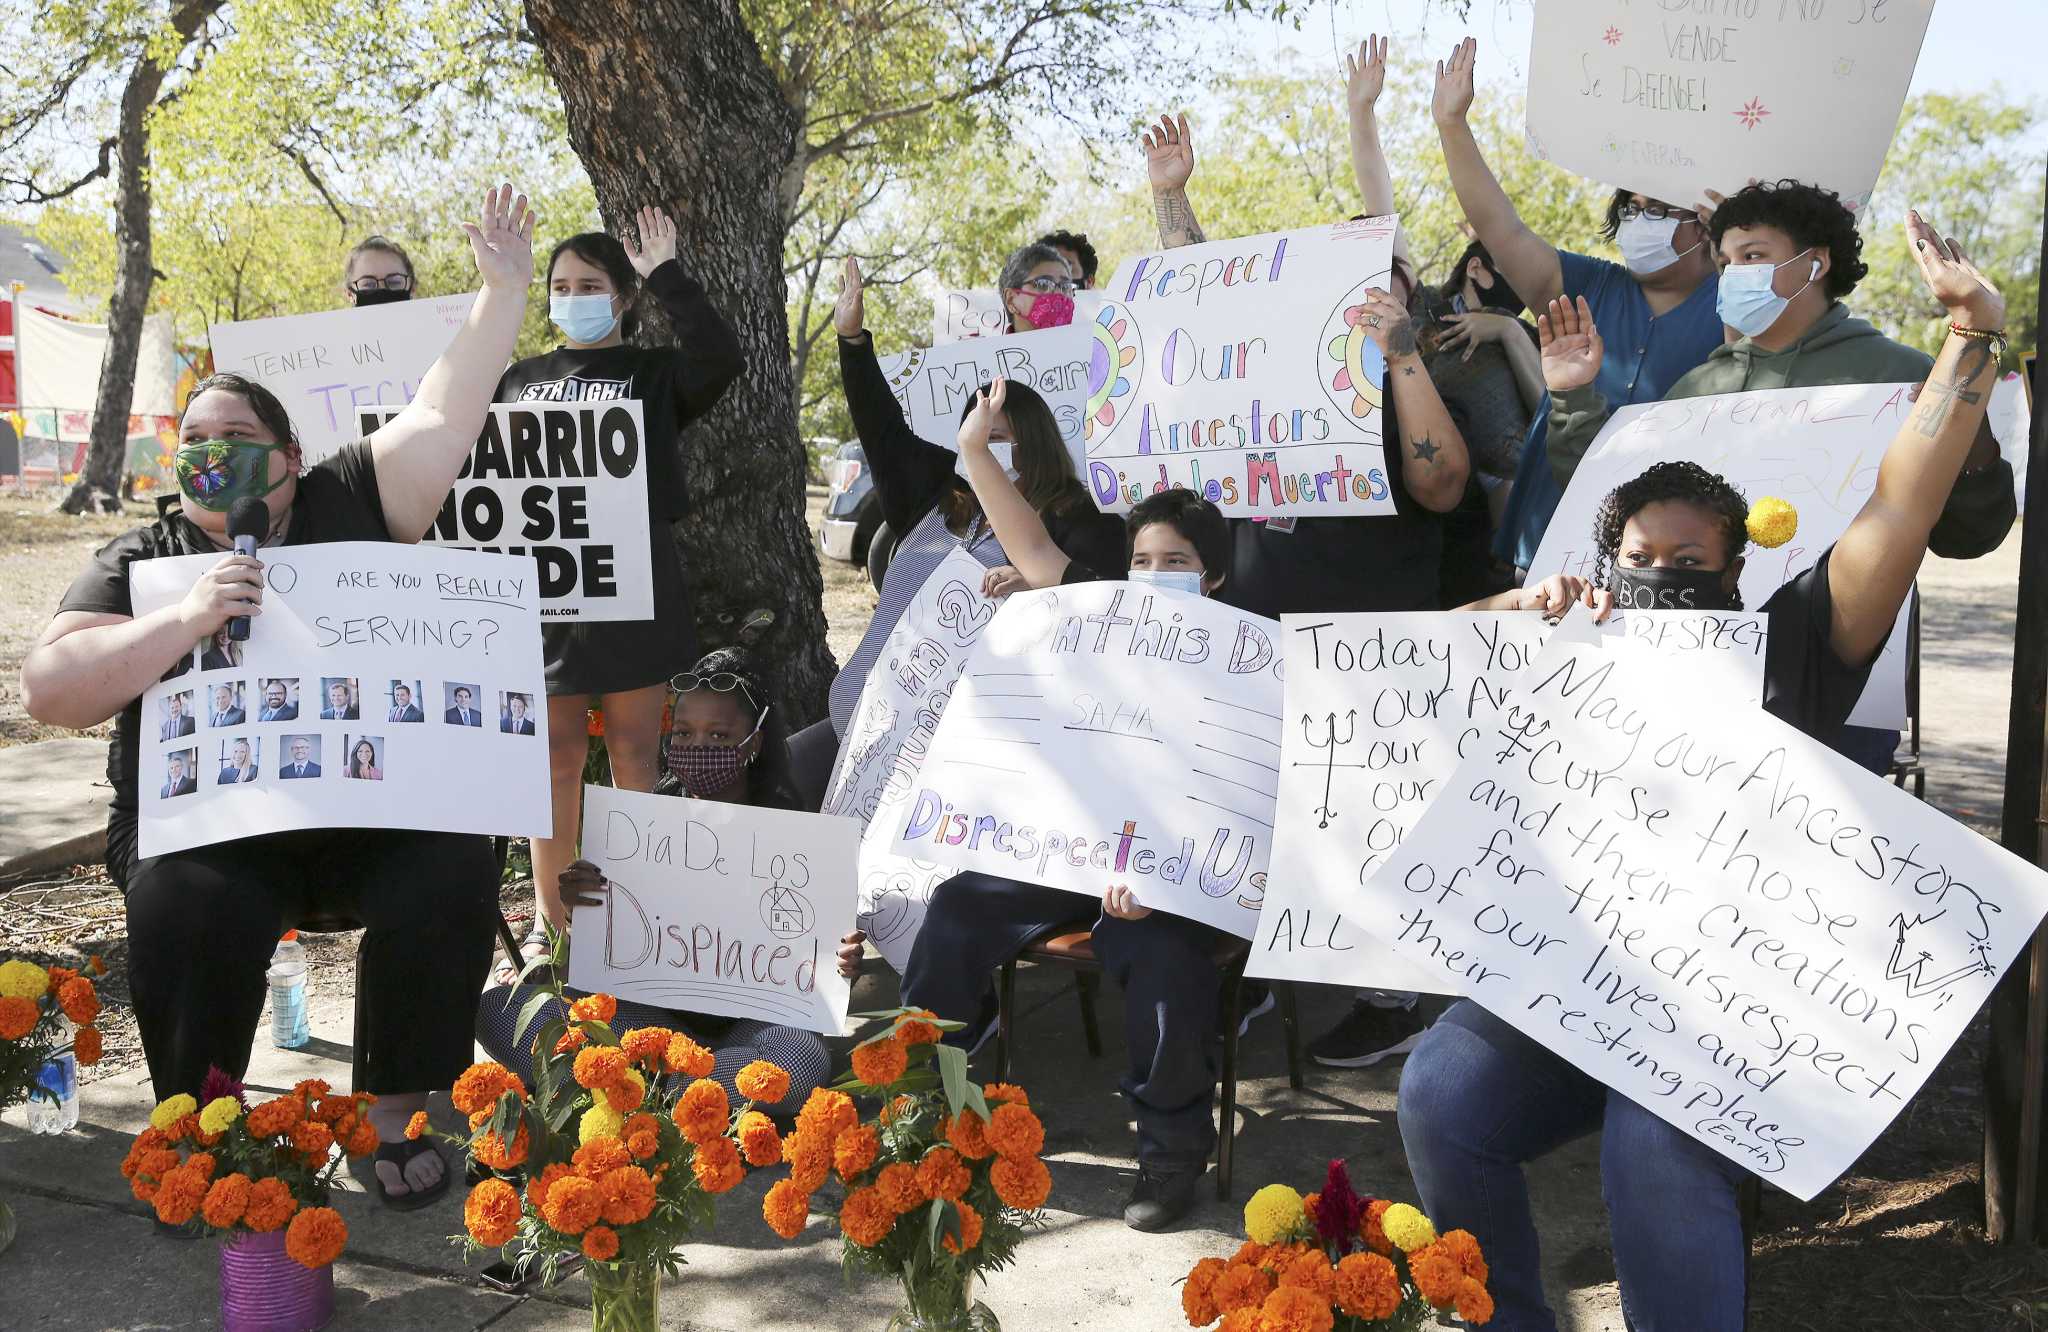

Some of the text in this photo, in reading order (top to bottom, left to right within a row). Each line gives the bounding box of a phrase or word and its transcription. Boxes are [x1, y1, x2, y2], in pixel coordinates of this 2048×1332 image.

[1662, 23, 1738, 62] VENDE
[1125, 238, 1298, 306] Respect
[242, 340, 384, 377] TENER UN
[996, 347, 1090, 393] Bar
[1161, 327, 1266, 386] Our
[522, 379, 626, 402] STRAIGHT
[455, 406, 639, 480] ARRIO
[1138, 400, 1330, 455] Ancestors
[1090, 461, 1143, 507] Dia
[1190, 459, 1239, 504] los
[1246, 451, 1389, 507] Muertos
[422, 484, 590, 542] NO SE
[336, 571, 524, 599] ARE YOU REALLY
[1618, 578, 1696, 610] BOSS
[315, 615, 500, 655] SERVING?
[1087, 589, 1210, 665] this
[1295, 622, 1452, 692] Today
[1532, 656, 1647, 776] May
[1737, 747, 2002, 942] Ancestors
[685, 820, 729, 876] De
[902, 788, 1268, 911] Disrespected Us
[1469, 779, 1562, 837] and
[1567, 818, 1694, 905] their
[1695, 809, 1859, 946] those
[604, 879, 818, 993] Displaced
[1268, 907, 1355, 953] ALL
[1475, 828, 1902, 1100] for the disrespect
[1397, 908, 1511, 984] their
[1527, 993, 1683, 1096] resting
[1582, 944, 1680, 1034] lives
[1697, 1033, 1787, 1092] and
[1695, 1118, 1786, 1173] (Earth)
